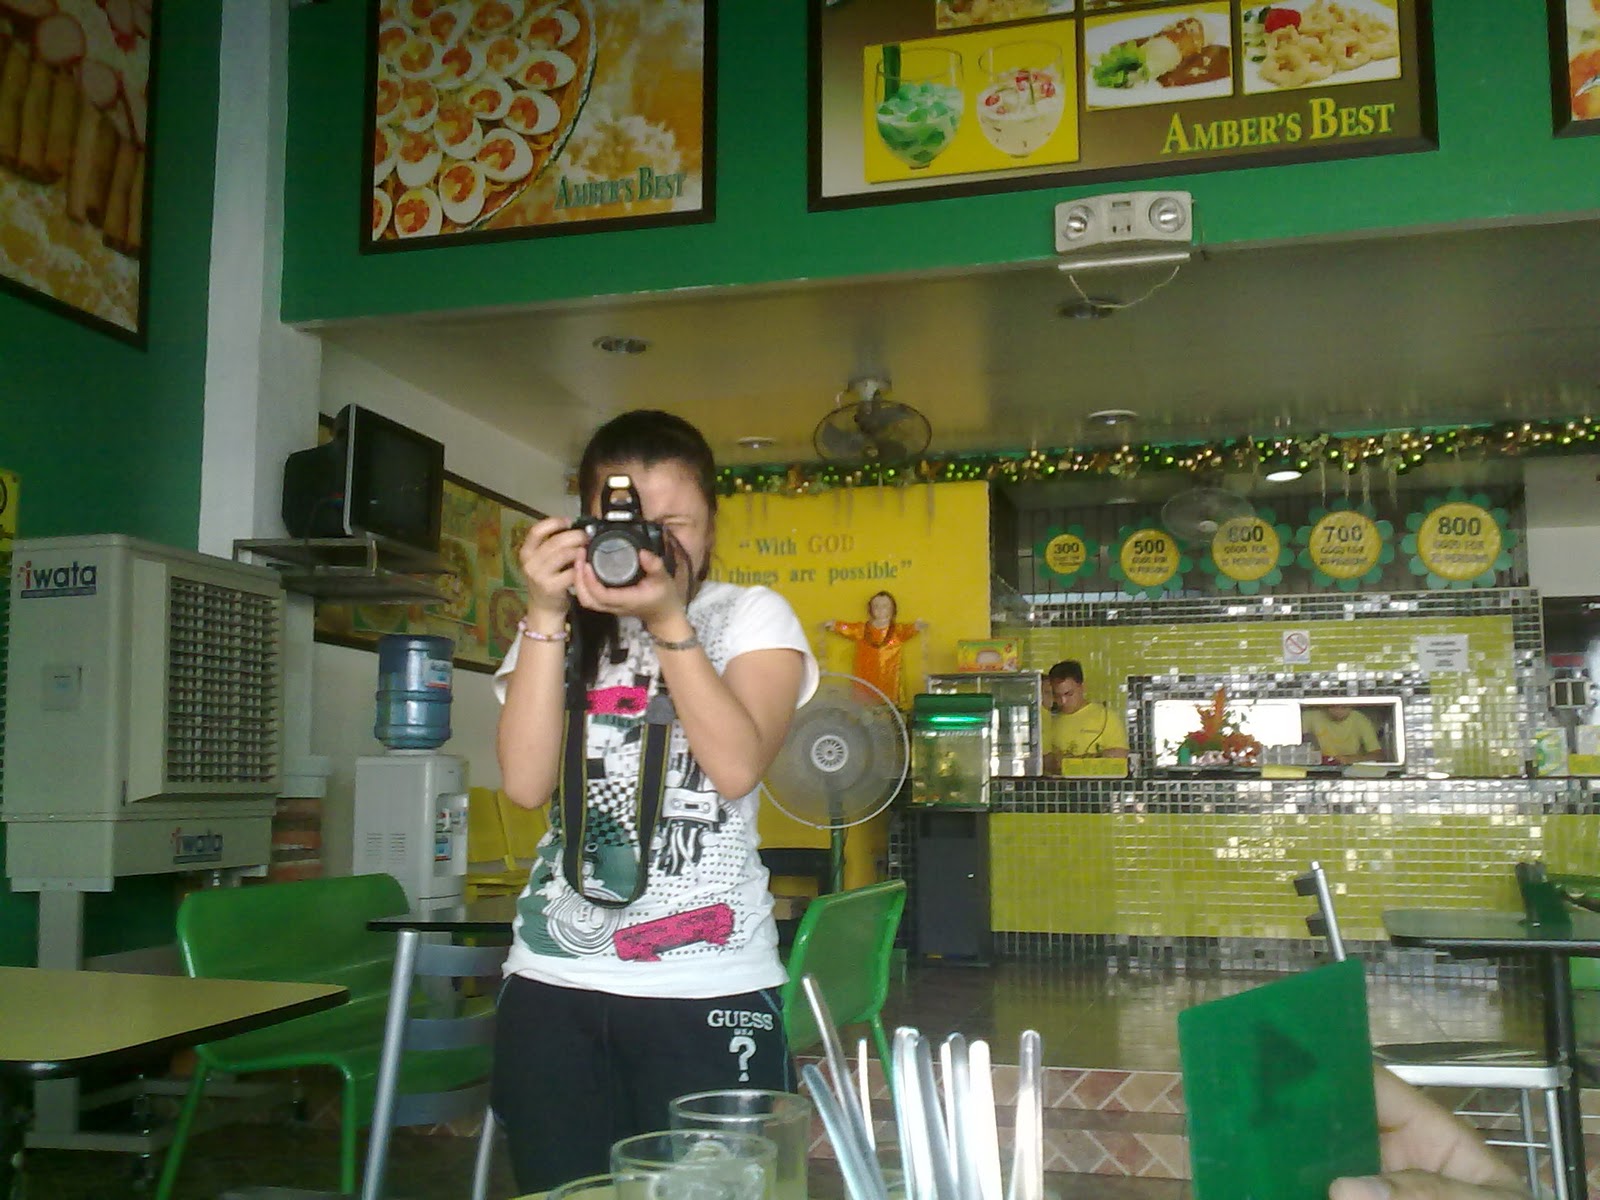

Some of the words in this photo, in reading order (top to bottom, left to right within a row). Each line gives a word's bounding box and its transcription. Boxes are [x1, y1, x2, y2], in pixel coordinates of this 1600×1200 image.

[1160, 111, 1303, 155] AMBER'S
[1309, 96, 1396, 141] BEST
[638, 167, 687, 201] BEST
[1323, 525, 1362, 543] 700
[1438, 516, 1481, 536] 800
[807, 534, 855, 554] GOD
[1053, 542, 1079, 554] 300
[1133, 539, 1165, 554] 500
[17, 560, 97, 589] iwata
[729, 566, 779, 585] things
[790, 568, 816, 583] are
[707, 1009, 774, 1031] GUESS
